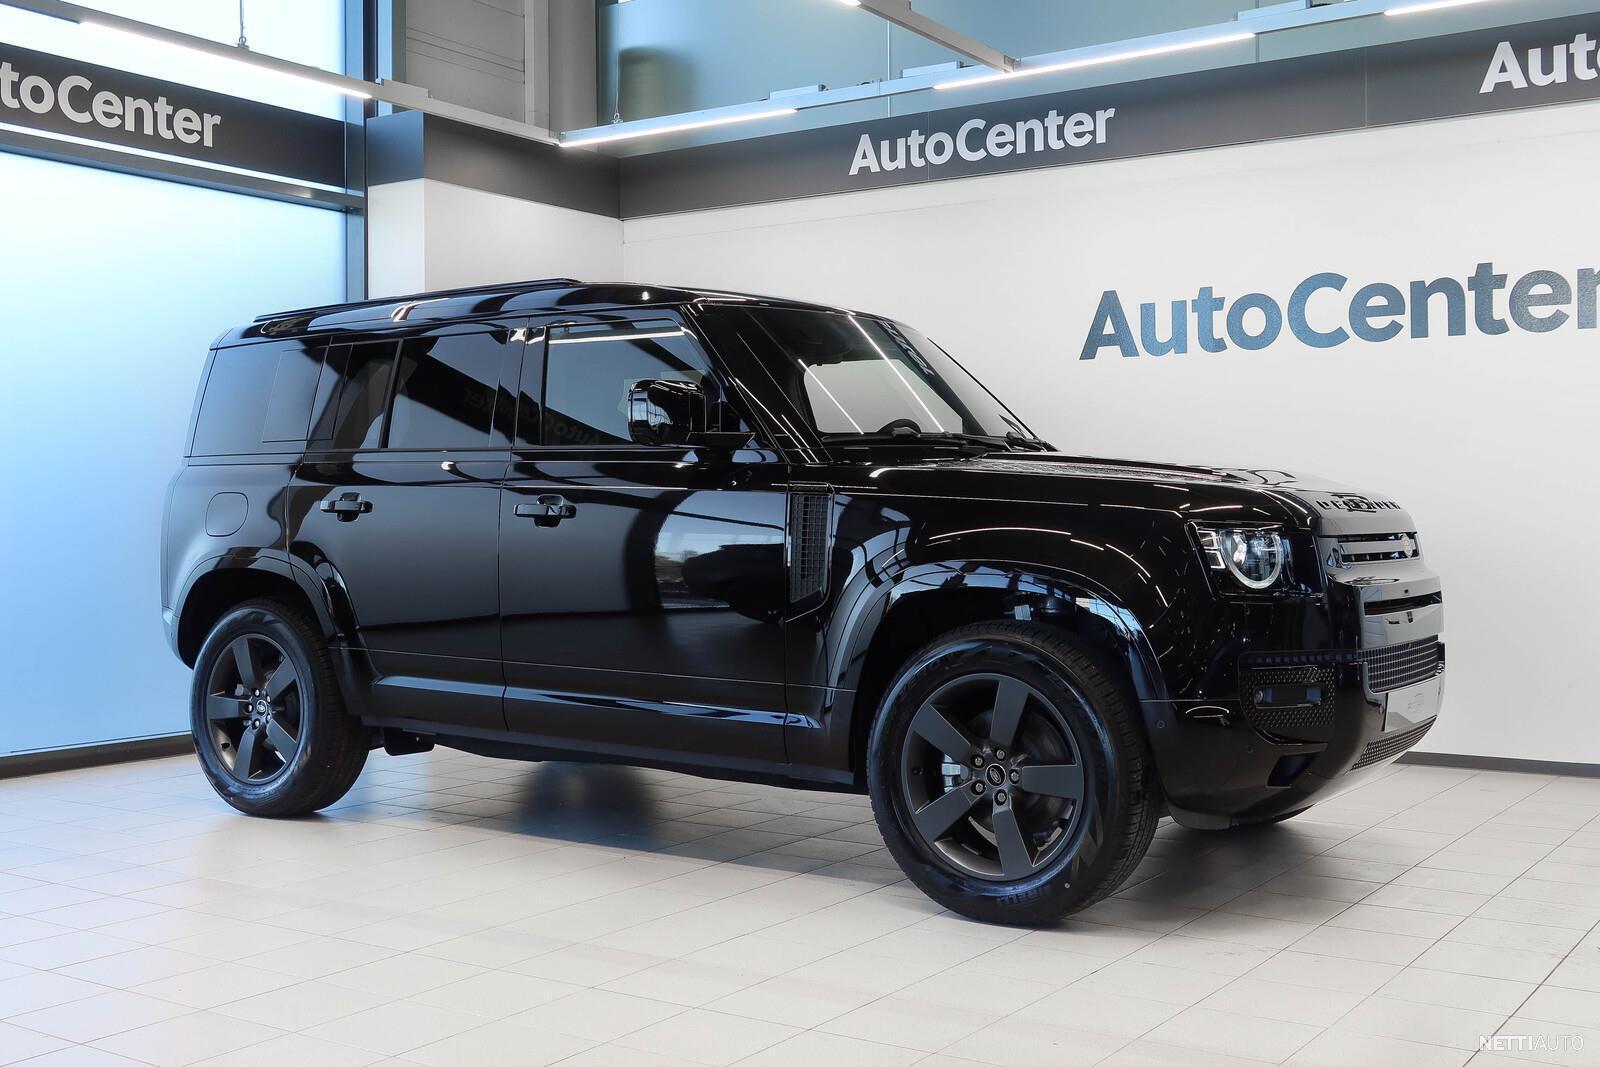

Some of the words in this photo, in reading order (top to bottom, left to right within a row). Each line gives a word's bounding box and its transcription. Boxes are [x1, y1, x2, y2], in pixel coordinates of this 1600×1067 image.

[1479, 33, 1600, 94] Aut
[848, 107, 1116, 176] AutoCenter
[1079, 262, 1600, 361] AutoCenter
